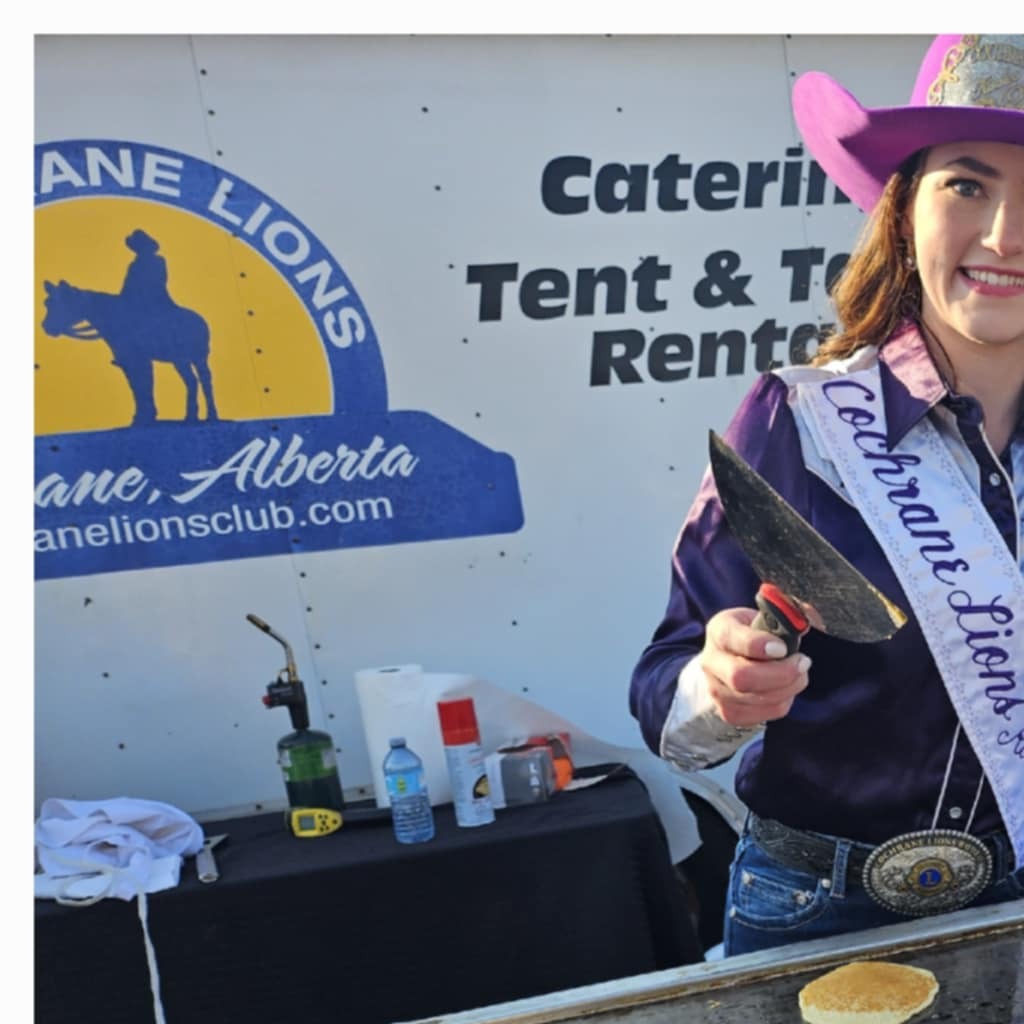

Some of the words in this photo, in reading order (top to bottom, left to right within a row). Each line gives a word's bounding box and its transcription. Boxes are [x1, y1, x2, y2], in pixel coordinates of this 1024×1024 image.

[540, 147, 852, 216] Caterin
[35, 146, 184, 198] ANE
[207, 177, 367, 349] LIONS
[466, 255, 672, 322] Tent
[693, 250, 756, 308] &
[589, 318, 835, 387] Renta
[171, 433, 419, 505] Alberta
[821, 378, 970, 588] Cochrane
[34, 496, 394, 552] anelionsclub.com
